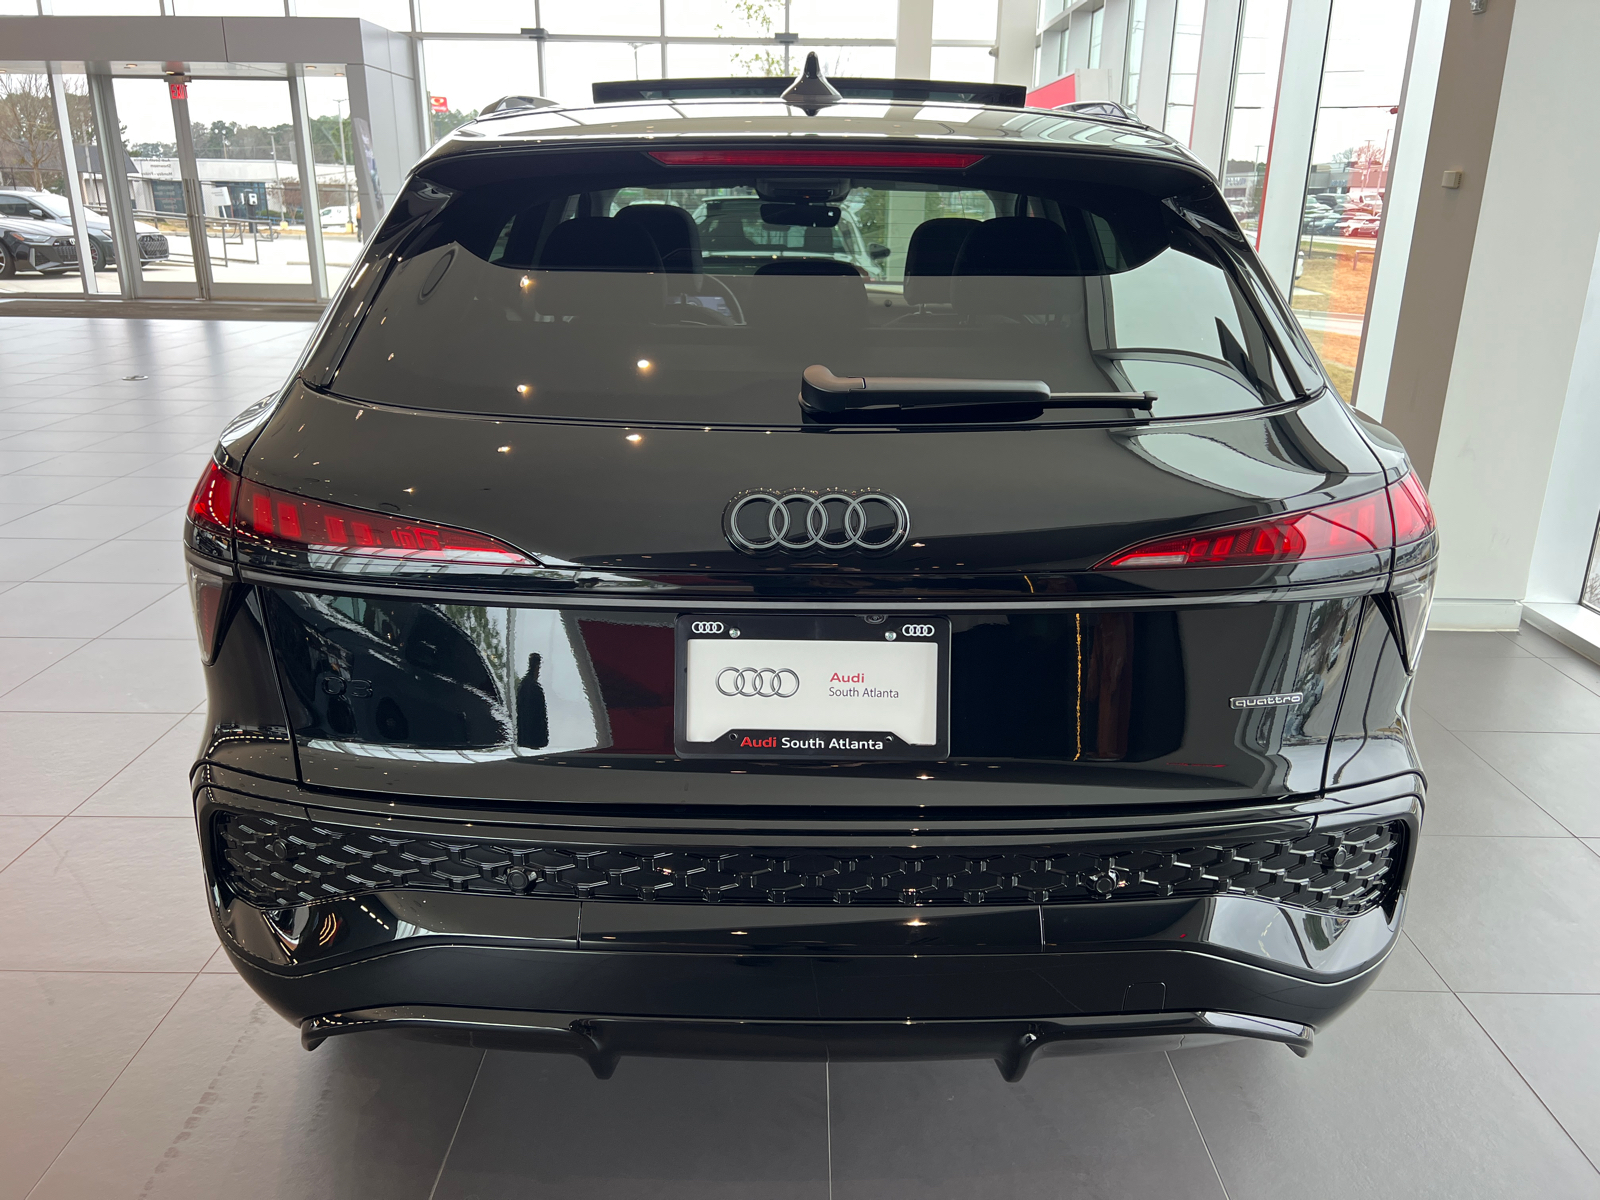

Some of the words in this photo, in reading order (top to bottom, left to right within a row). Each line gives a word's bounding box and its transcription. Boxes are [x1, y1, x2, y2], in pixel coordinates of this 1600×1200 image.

[170, 84, 188, 99] EXIT
[829, 672, 865, 683] Audi
[322, 675, 373, 701] Q3
[828, 686, 860, 697] South
[862, 687, 899, 698] Atlanta
[1235, 695, 1301, 707] quattro
[740, 736, 777, 748] Audi
[781, 737, 825, 749] South
[828, 738, 883, 750] Atlanta
